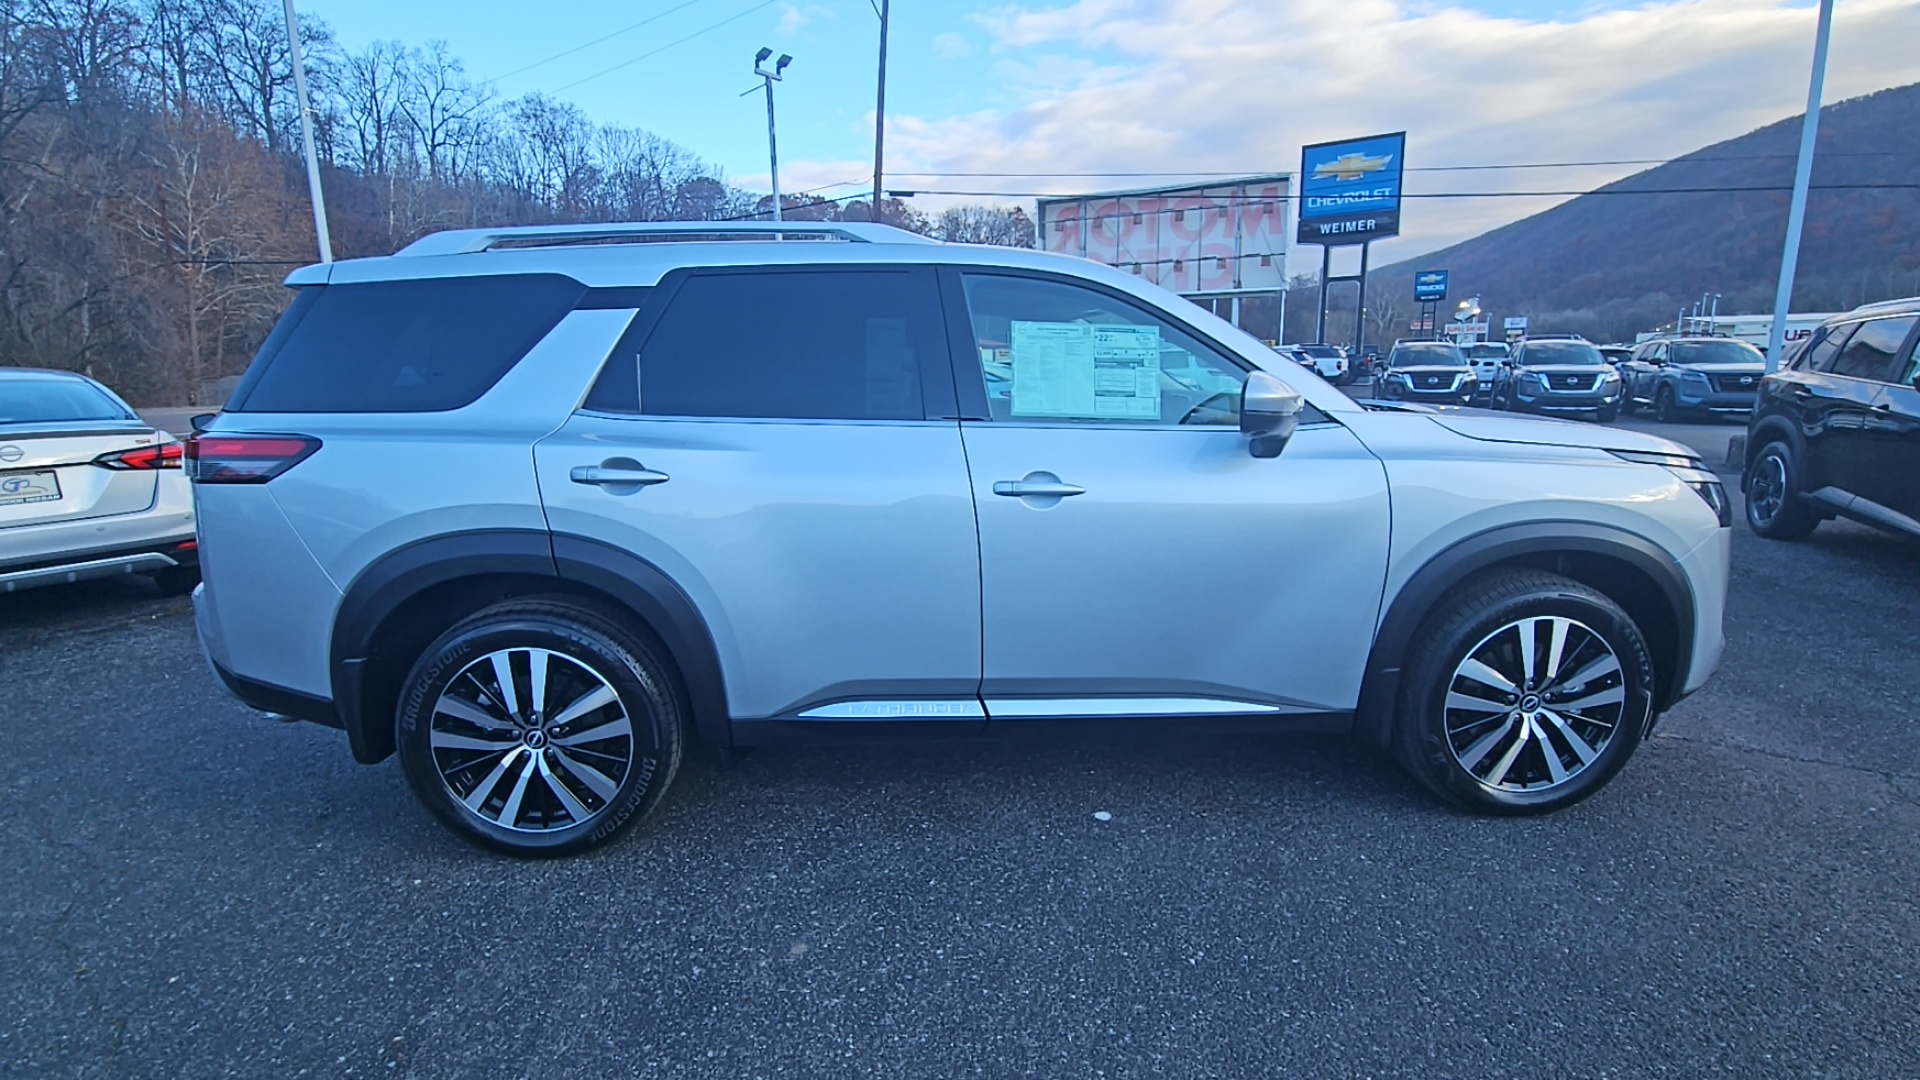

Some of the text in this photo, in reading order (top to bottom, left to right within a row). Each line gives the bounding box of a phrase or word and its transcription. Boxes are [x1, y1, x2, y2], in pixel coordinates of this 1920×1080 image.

[1308, 187, 1392, 208] CHEVROLET
[1320, 219, 1376, 234] WEIMER
[1098, 334, 1109, 342] 22
[401, 643, 471, 732] BRIDGESTONE
[849, 703, 974, 714] PATHFINDER
[588, 756, 657, 843] BRIDGESTONE
